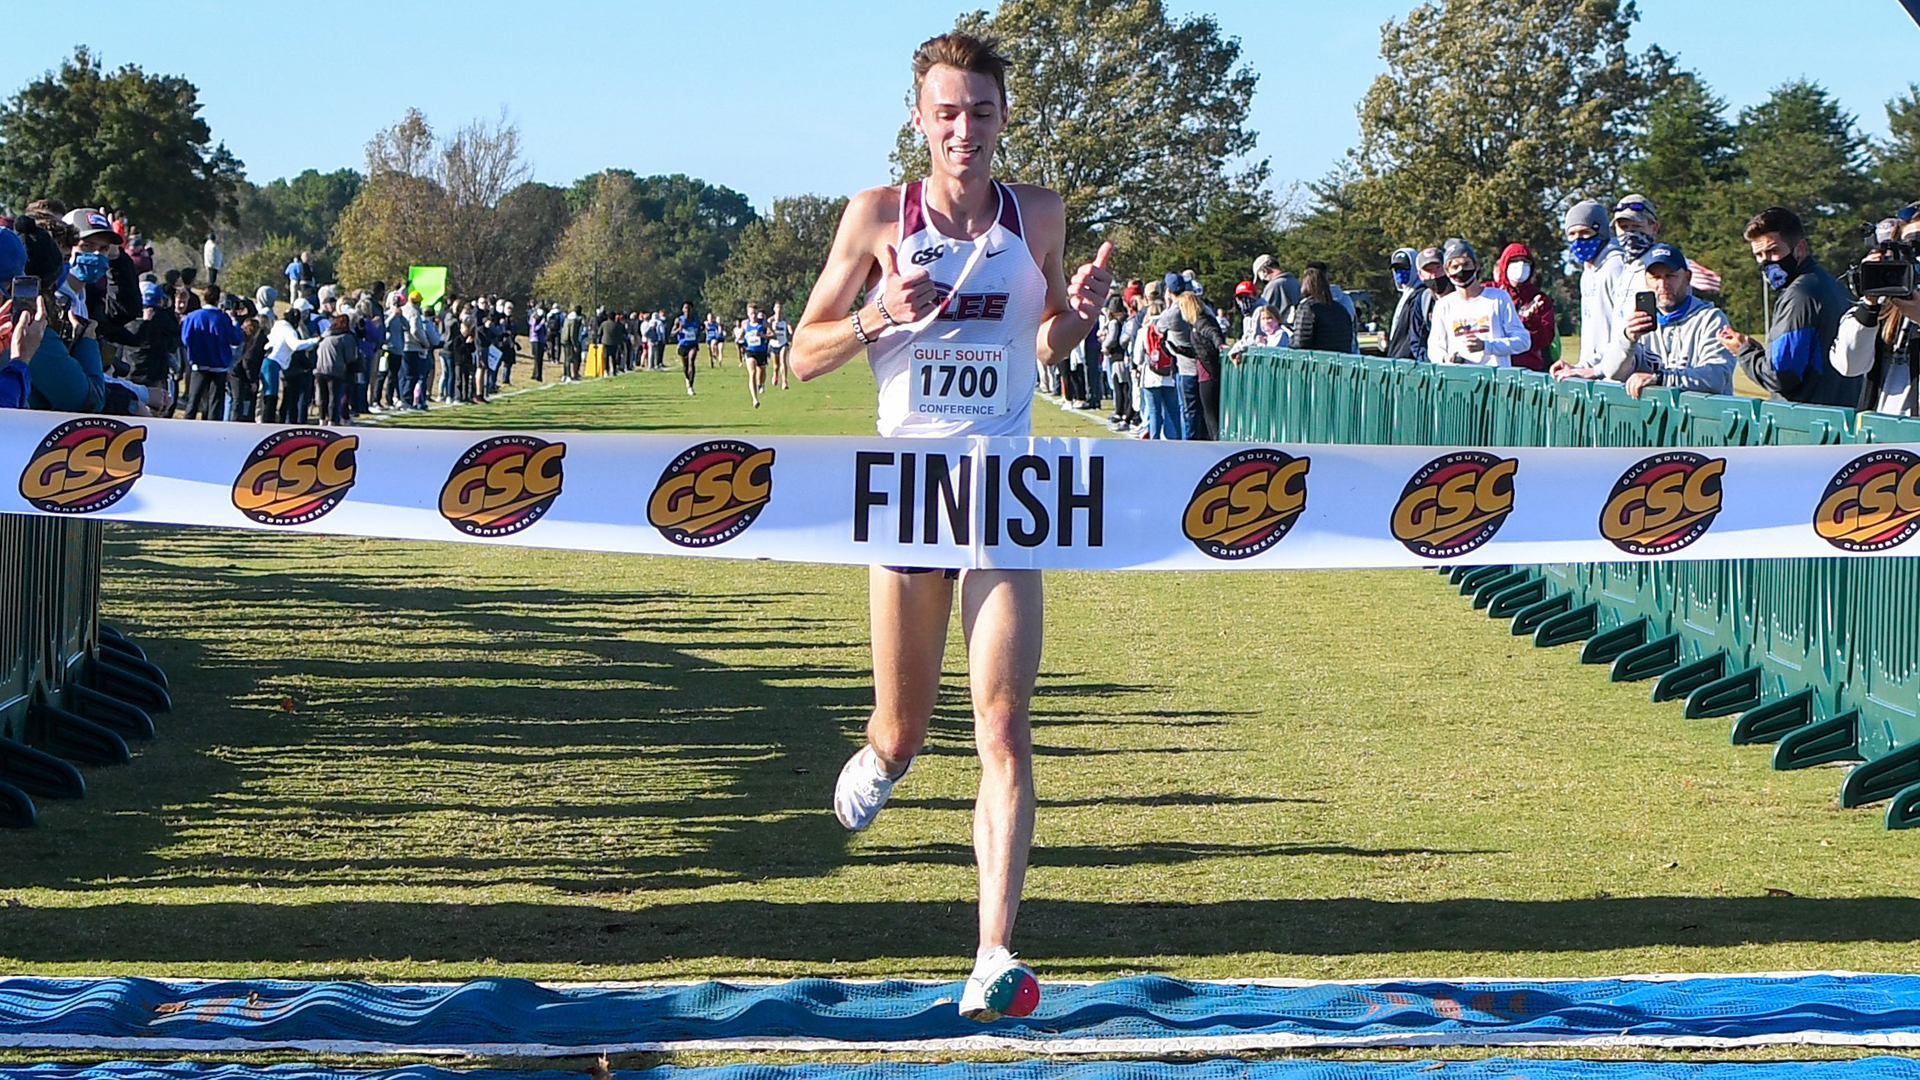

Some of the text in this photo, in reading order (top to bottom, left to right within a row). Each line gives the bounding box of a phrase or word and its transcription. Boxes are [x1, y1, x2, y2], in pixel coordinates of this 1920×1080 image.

[911, 244, 944, 265] GSC
[936, 292, 1010, 322] LEE
[914, 349, 1002, 362] GULF SOUTH
[920, 365, 998, 398] 1700
[919, 404, 995, 415] CONFERENCE
[46, 420, 118, 448] GULF SOUTH
[257, 430, 330, 457] GULF SOUTH
[21, 426, 146, 499] GSC
[463, 438, 536, 465] GULF SOUTH
[672, 443, 745, 472] GULF SOUTH
[233, 435, 357, 511] GSC
[441, 444, 565, 519] GSC
[1206, 453, 1281, 485] GULF SOUTH
[1414, 455, 1489, 485] GULF SOUTH
[1623, 454, 1697, 486] GULF SOUTH
[1835, 454, 1909, 485] GULF SOUTH
[46, 488, 122, 513] CONFERENCE
[650, 450, 774, 527] GSC
[854, 451, 1104, 547] FINISH
[1185, 458, 1308, 539] GSC
[1394, 460, 1516, 540] GSC
[1602, 460, 1724, 540] GSC
[1816, 463, 1920, 539] GSC
[258, 497, 336, 525] CONFERENCE
[466, 505, 543, 535] CONFERENCE
[675, 513, 751, 544] CONFERENCE
[1211, 524, 1287, 556] CONFERENCE
[1420, 524, 1495, 555] CONFERENCE
[1629, 525, 1704, 554] CONFERENCE
[1844, 522, 1918, 551] CONFERENCE
